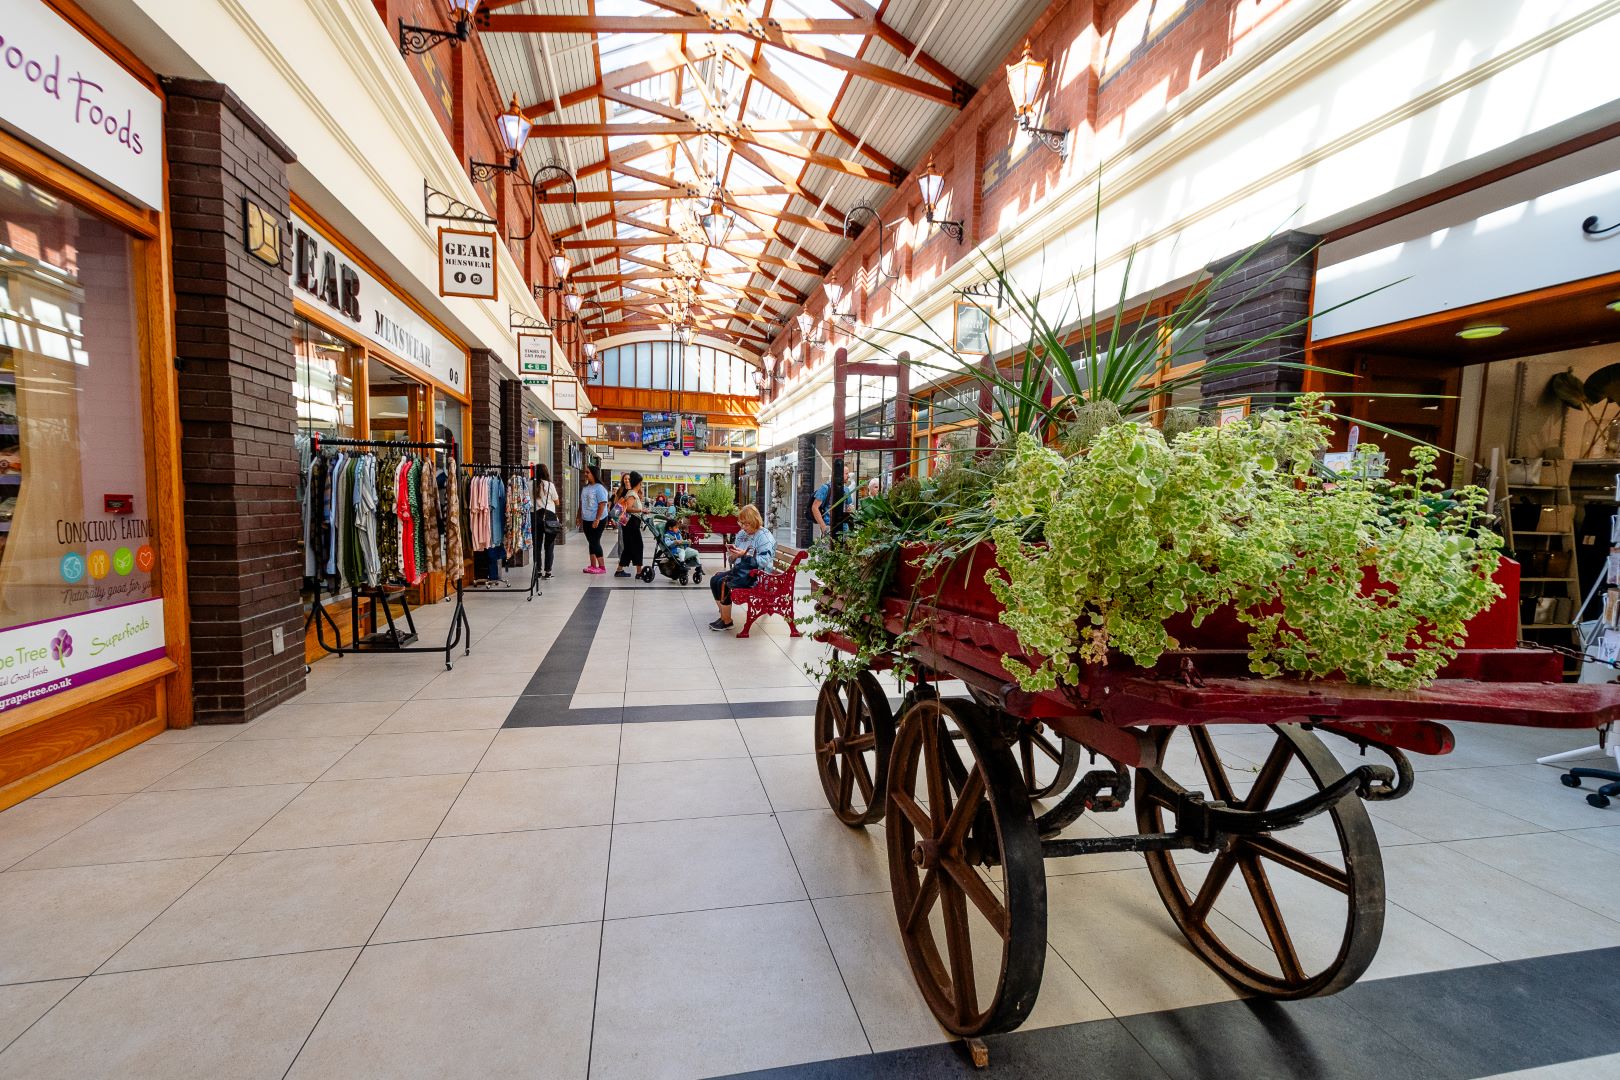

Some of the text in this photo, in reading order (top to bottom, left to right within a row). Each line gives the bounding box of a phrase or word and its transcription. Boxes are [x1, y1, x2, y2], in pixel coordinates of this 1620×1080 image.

[0, 36, 143, 155] ood Foods
[445, 242, 490, 259] GEAR
[445, 258, 491, 269] MENSWEAR
[291, 224, 432, 368] EAR MENSWEAR
[57, 517, 154, 544] CONSCIOUS EATING
[61, 586, 105, 604] Naturally
[107, 583, 128, 600] good
[126, 579, 141, 597] for
[89, 616, 151, 656] Superfoods
[16, 646, 48, 665] Tree
[10, 669, 31, 685] Good
[32, 665, 49, 679] Foods
